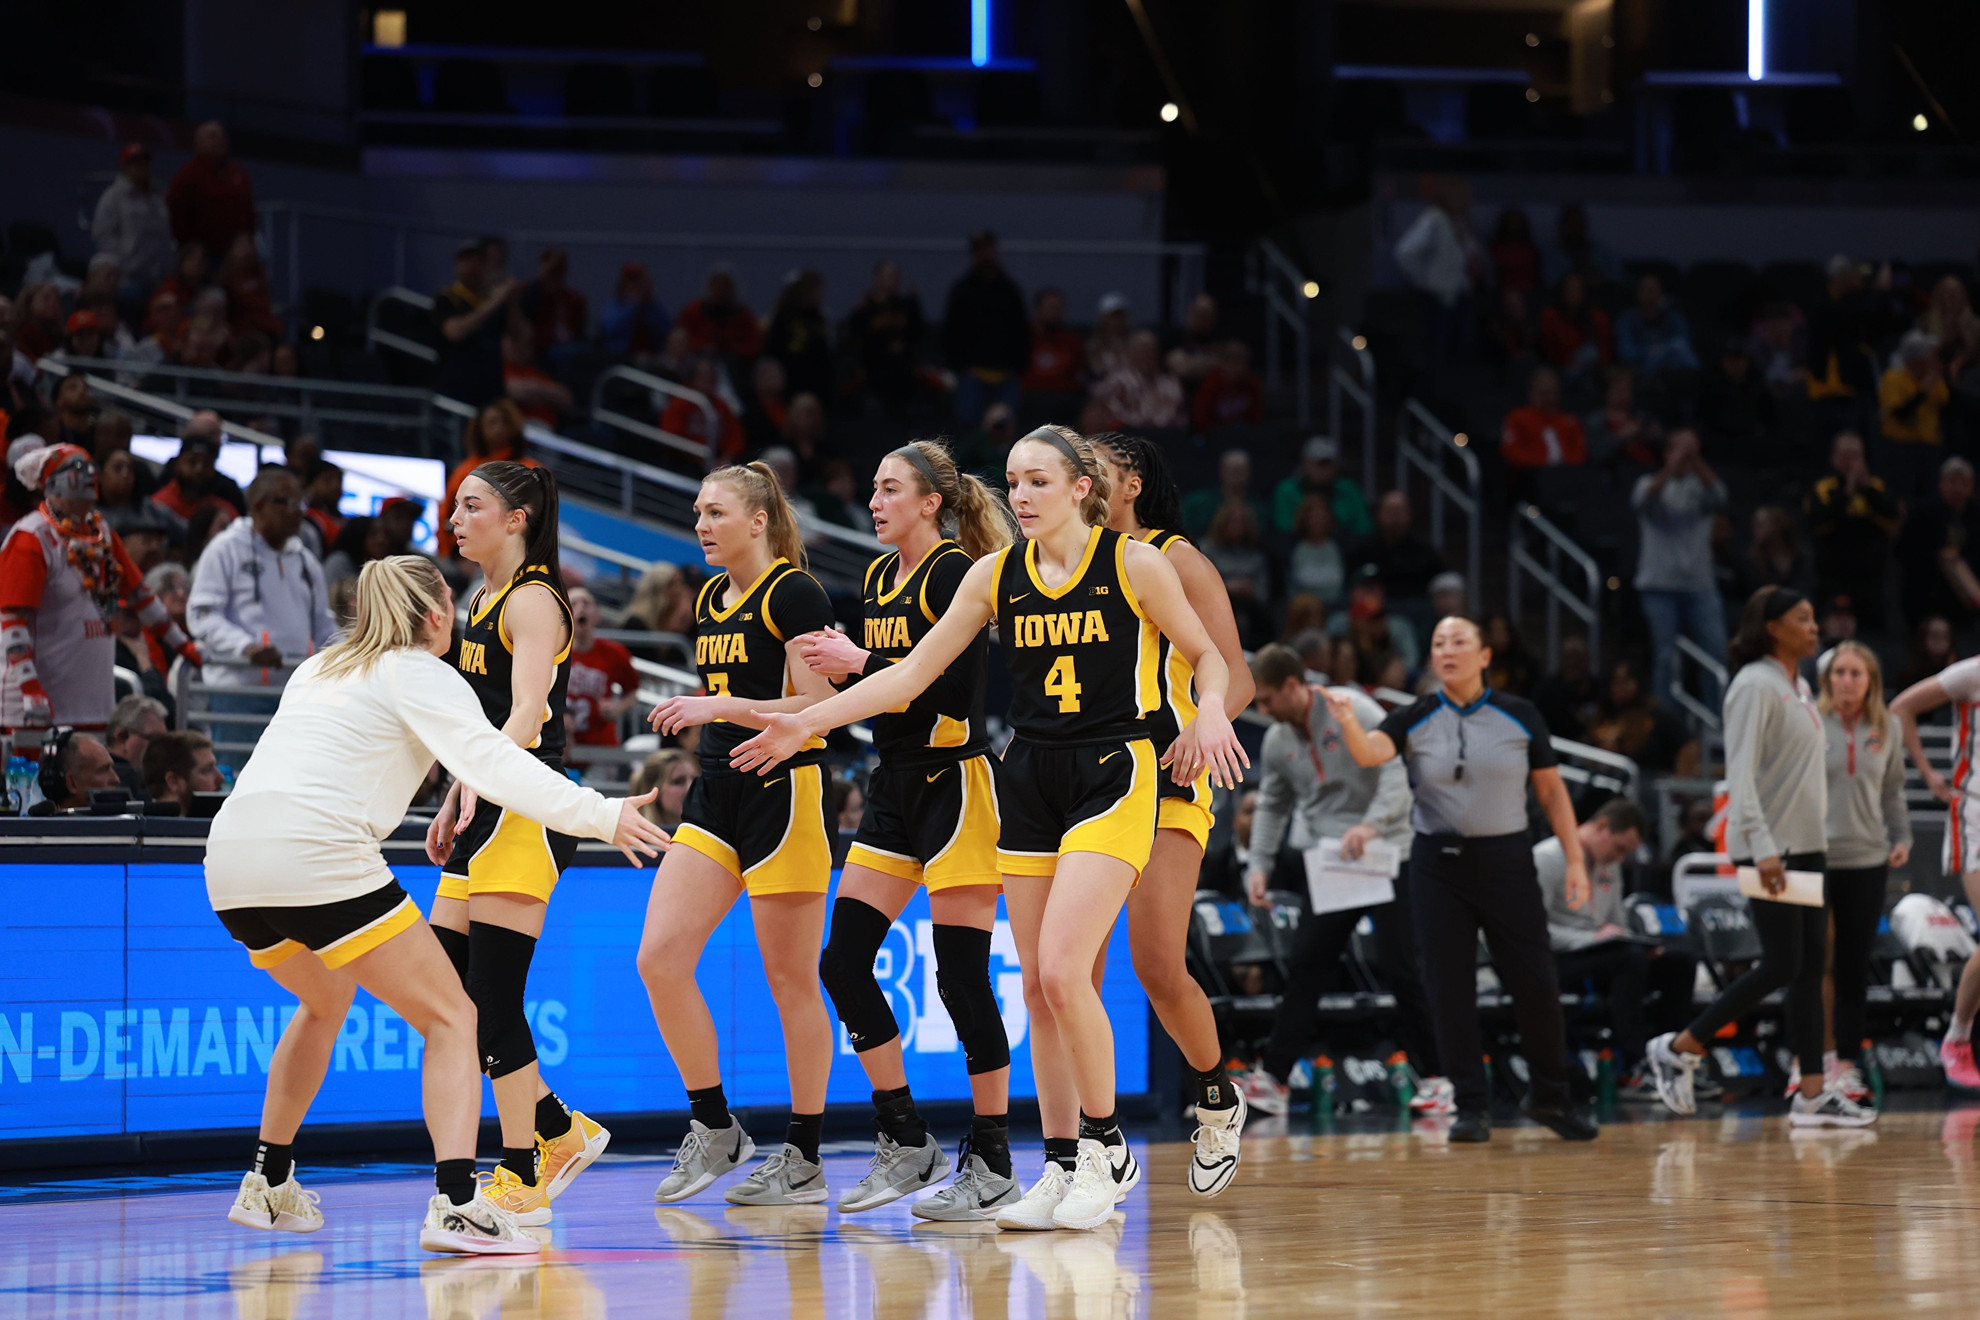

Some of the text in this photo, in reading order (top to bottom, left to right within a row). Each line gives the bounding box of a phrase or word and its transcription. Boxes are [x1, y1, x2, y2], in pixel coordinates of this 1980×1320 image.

[864, 616, 912, 649] OWA
[1014, 609, 1109, 648] IOWA
[696, 633, 748, 665] OWA
[1044, 655, 1082, 713] 4
